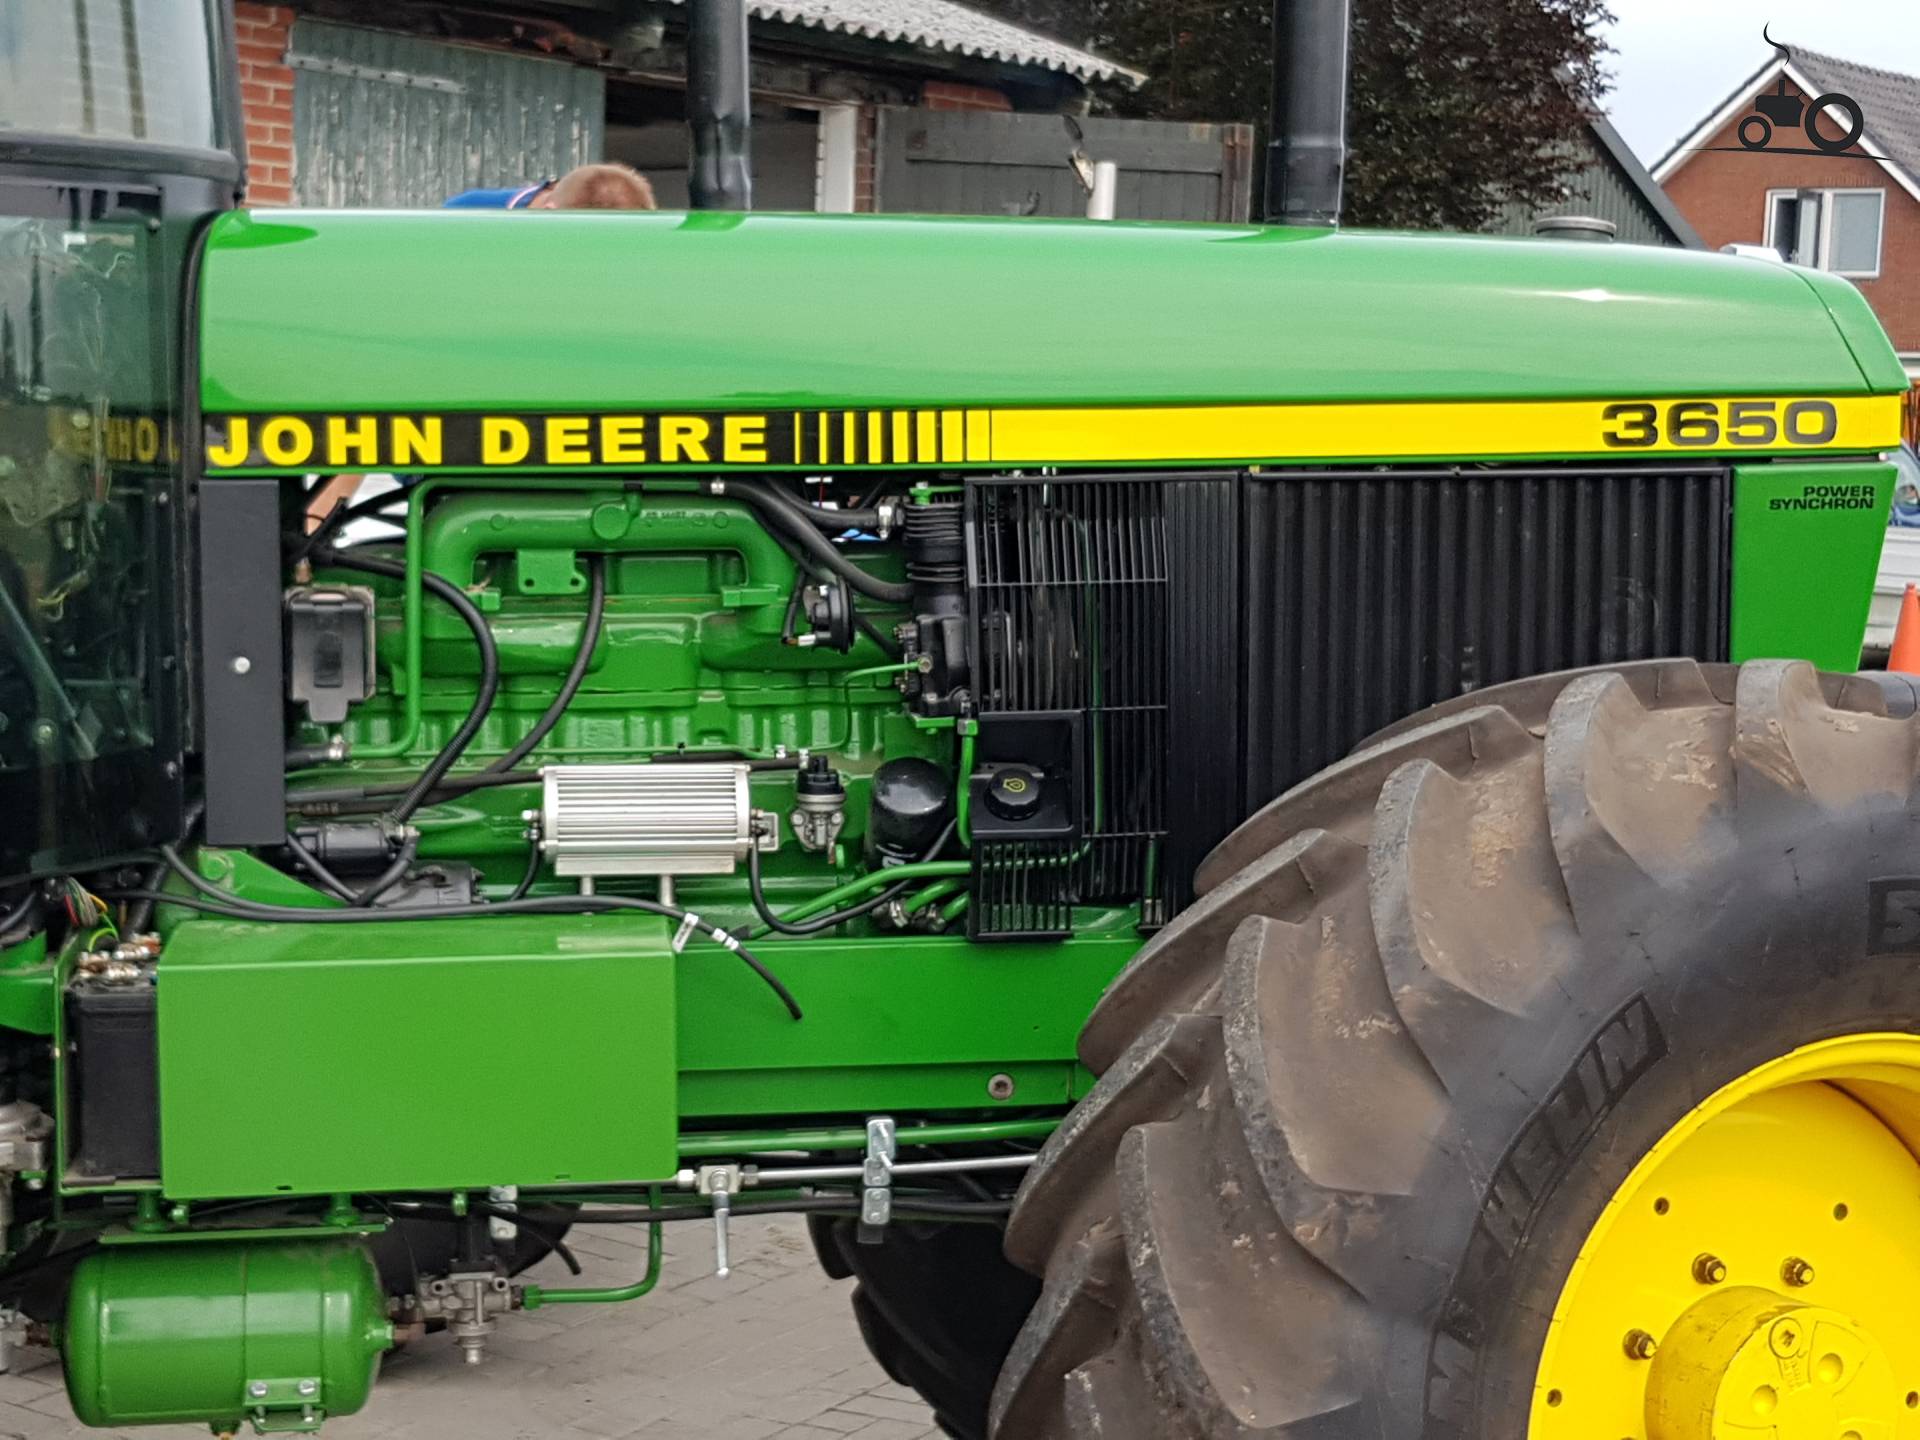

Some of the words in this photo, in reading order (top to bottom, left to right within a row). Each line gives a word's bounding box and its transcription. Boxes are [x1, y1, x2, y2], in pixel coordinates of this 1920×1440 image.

[1601, 400, 1838, 448] 3650
[207, 415, 443, 467] JOHN
[481, 415, 768, 465] DEERE
[1769, 498, 1874, 510] SYNCHRON
[1803, 485, 1875, 498] POWER
